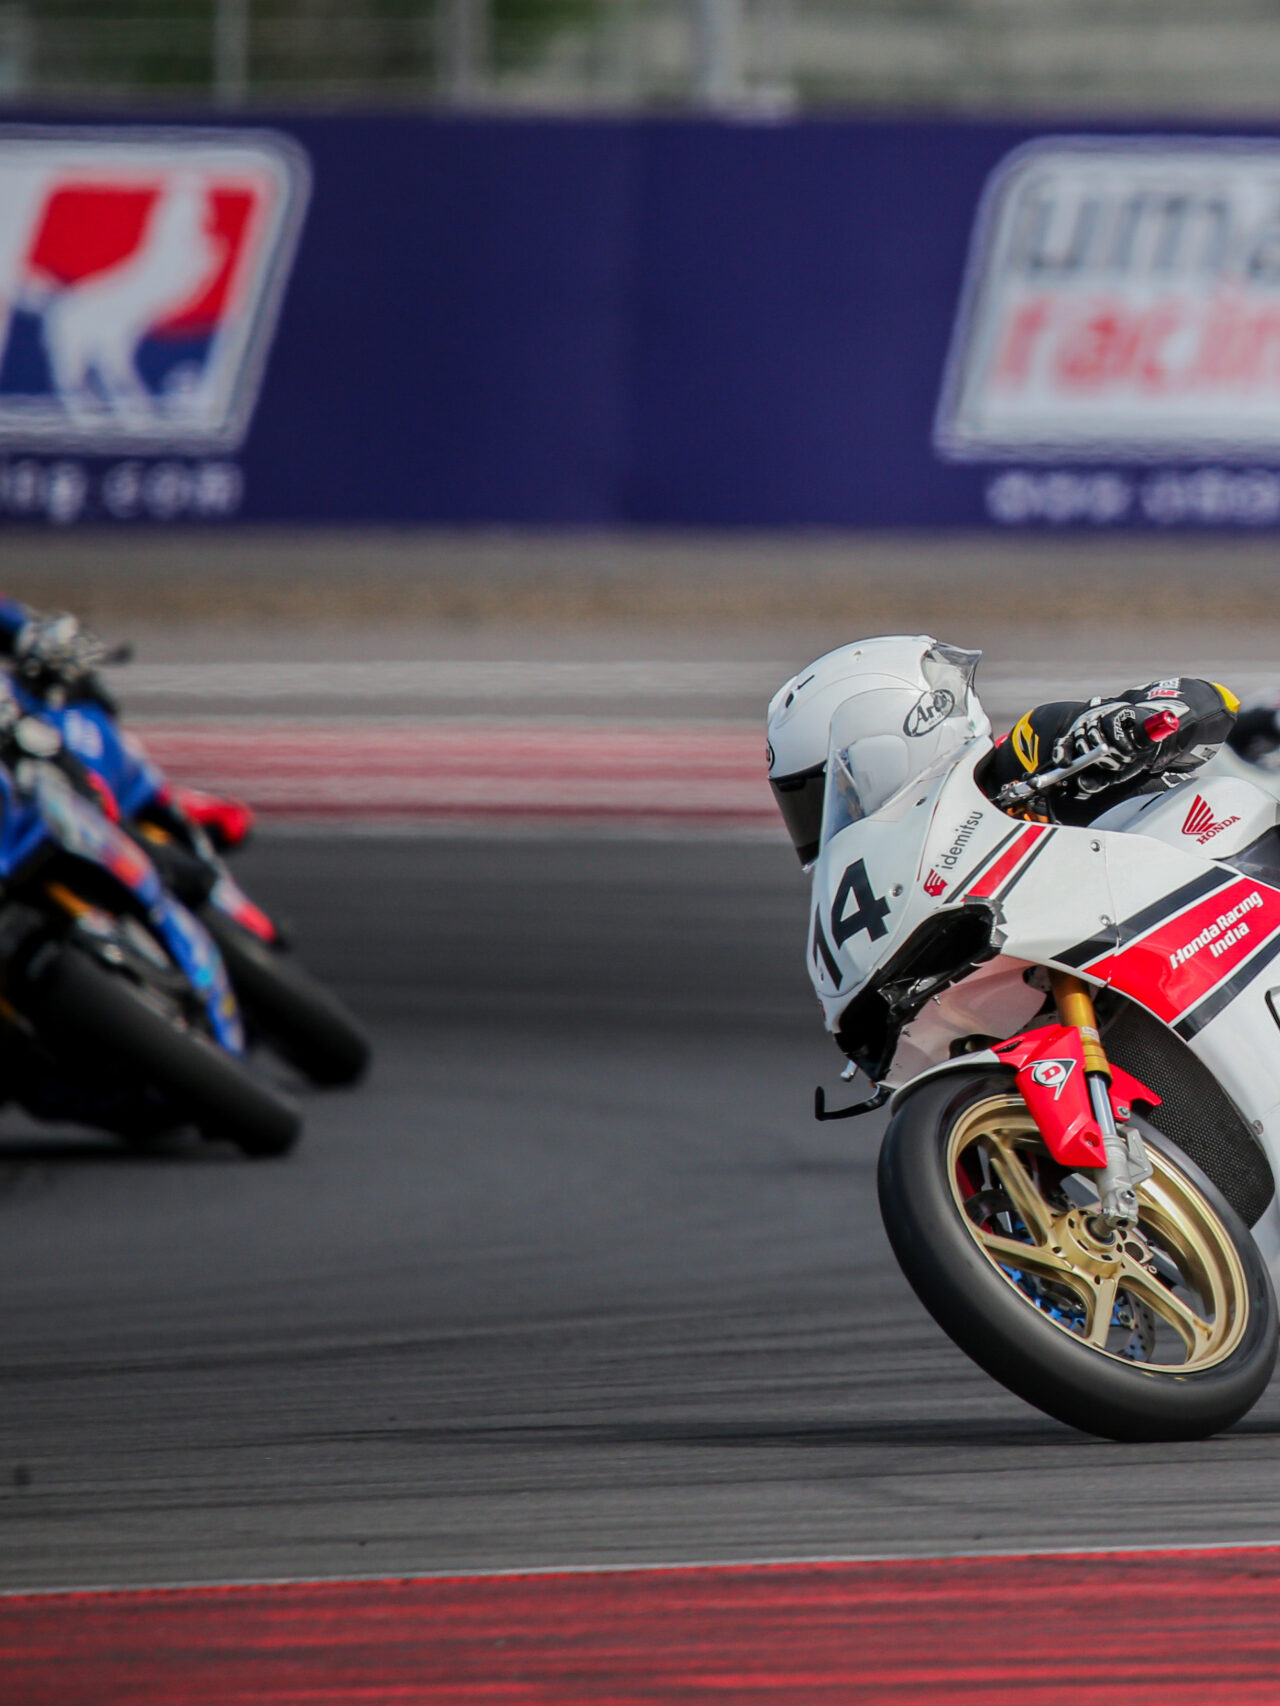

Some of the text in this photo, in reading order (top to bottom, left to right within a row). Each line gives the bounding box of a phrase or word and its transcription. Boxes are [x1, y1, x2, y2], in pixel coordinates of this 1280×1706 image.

[935, 810, 984, 871] idemitsu
[1196, 815, 1241, 845] HONDA
[812, 857, 891, 991] 14
[1169, 891, 1264, 969] Honda Racing
[1209, 921, 1251, 958] India
